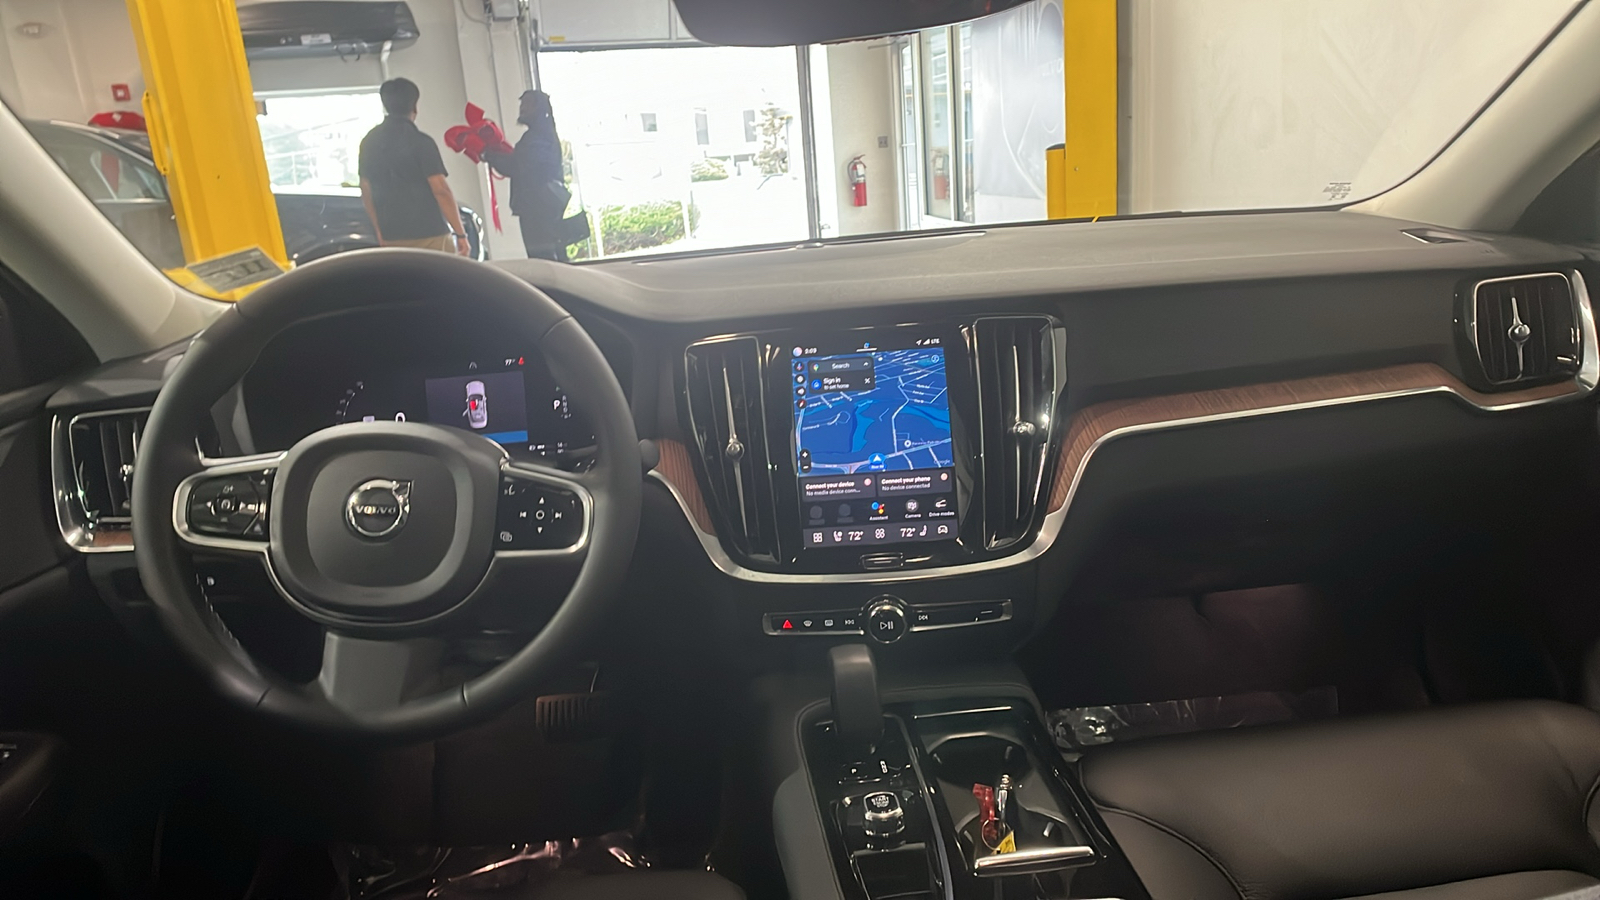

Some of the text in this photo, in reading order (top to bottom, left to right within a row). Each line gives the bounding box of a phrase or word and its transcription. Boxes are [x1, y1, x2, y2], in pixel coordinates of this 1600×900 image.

[831, 362, 850, 370] Search
[823, 377, 835, 385] Sign
[553, 399, 561, 410] P
[881, 477, 903, 485] Connect
[805, 482, 826, 490] Connect
[355, 505, 396, 515] VOLVO
